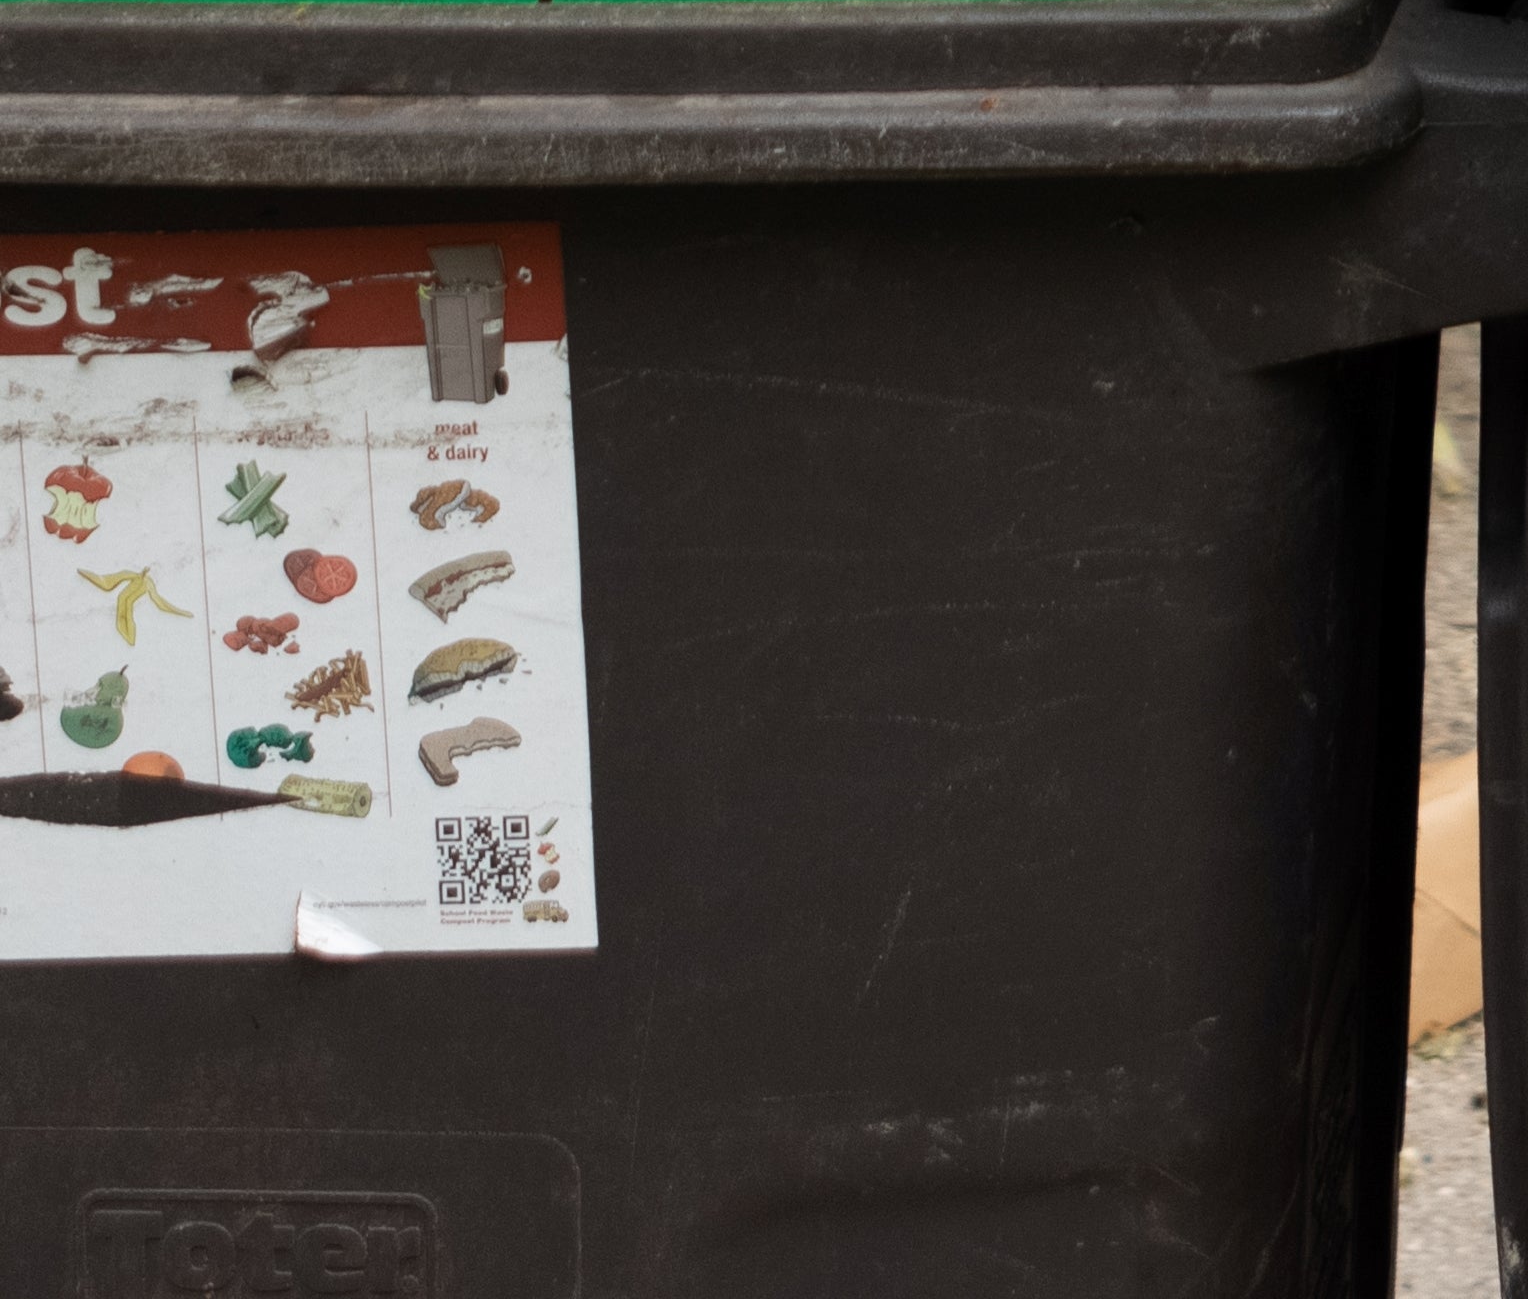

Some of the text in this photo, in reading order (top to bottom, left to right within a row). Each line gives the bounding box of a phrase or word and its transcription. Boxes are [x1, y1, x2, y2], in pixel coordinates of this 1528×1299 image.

[0, 247, 117, 327] st
[434, 419, 479, 436] meat
[427, 444, 489, 463] & dairy
